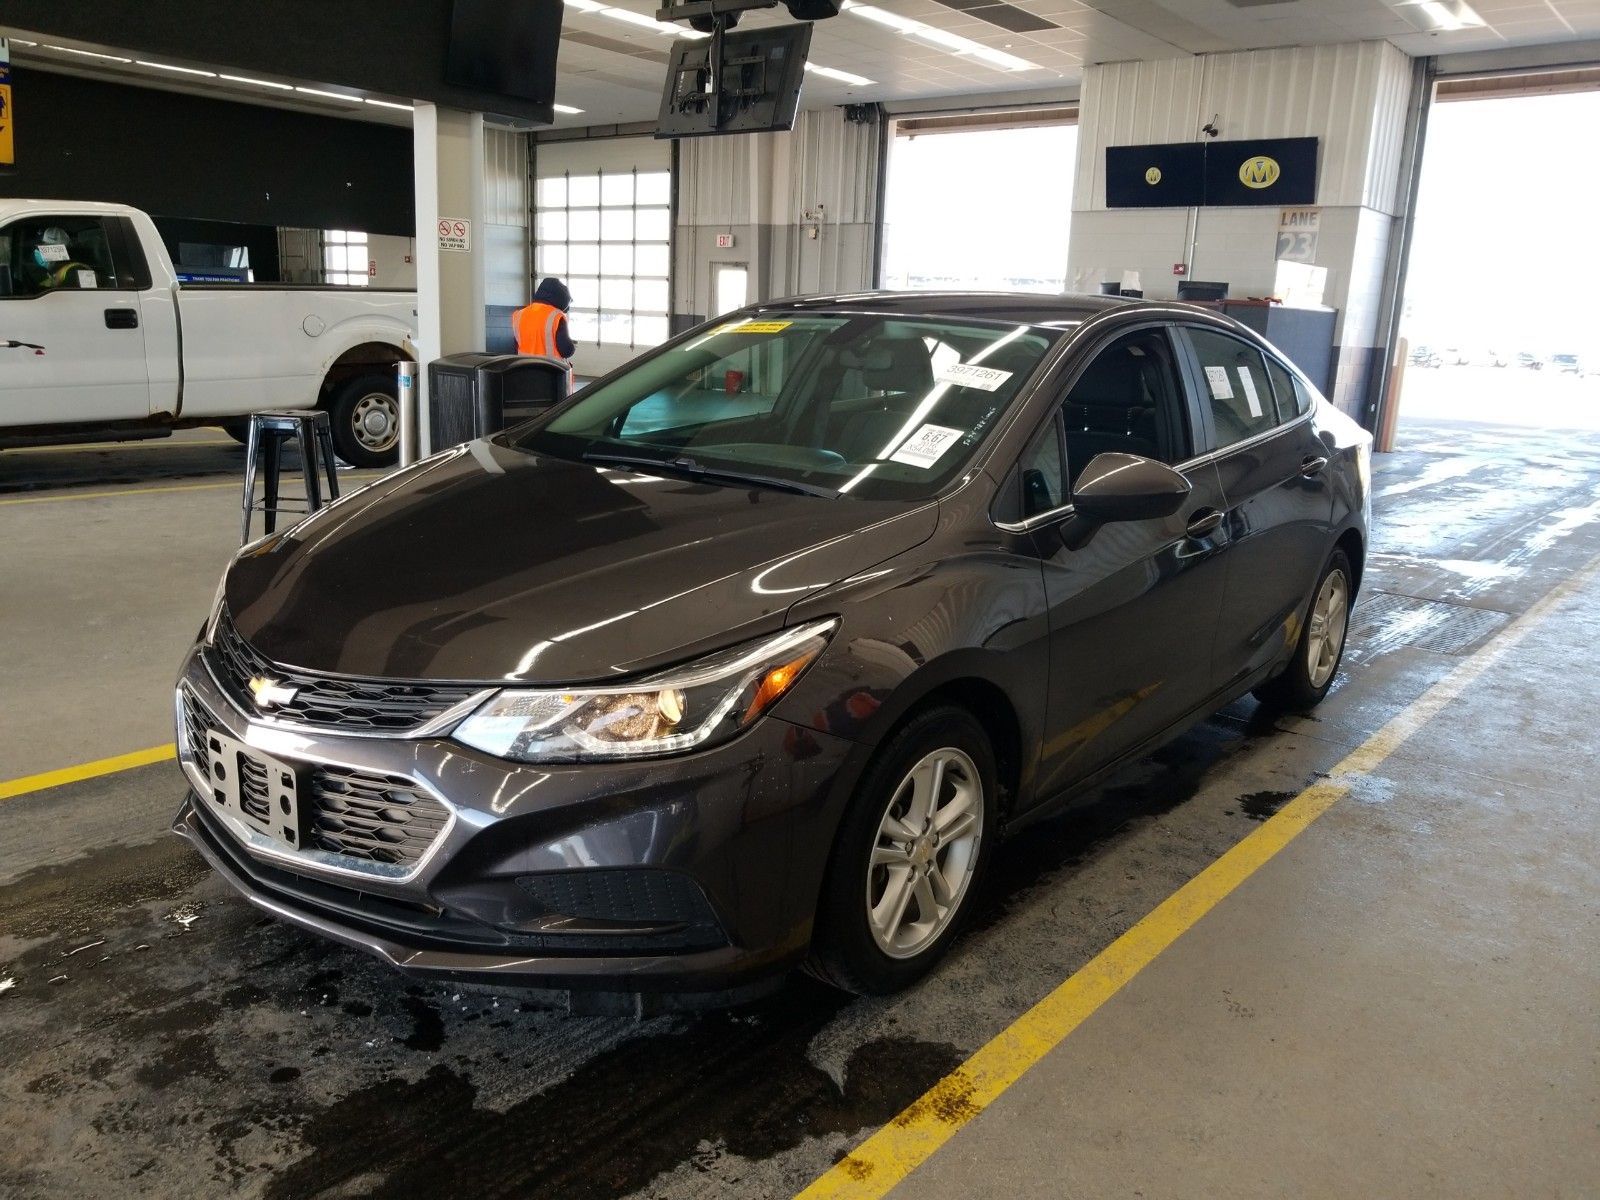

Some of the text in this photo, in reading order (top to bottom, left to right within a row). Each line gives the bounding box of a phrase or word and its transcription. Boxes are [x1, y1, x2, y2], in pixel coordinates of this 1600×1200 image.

[1281, 211, 1318, 226] LANE
[719, 235, 730, 247] EXIT
[1278, 232, 1312, 259] 23
[946, 365, 1003, 381] 3971261
